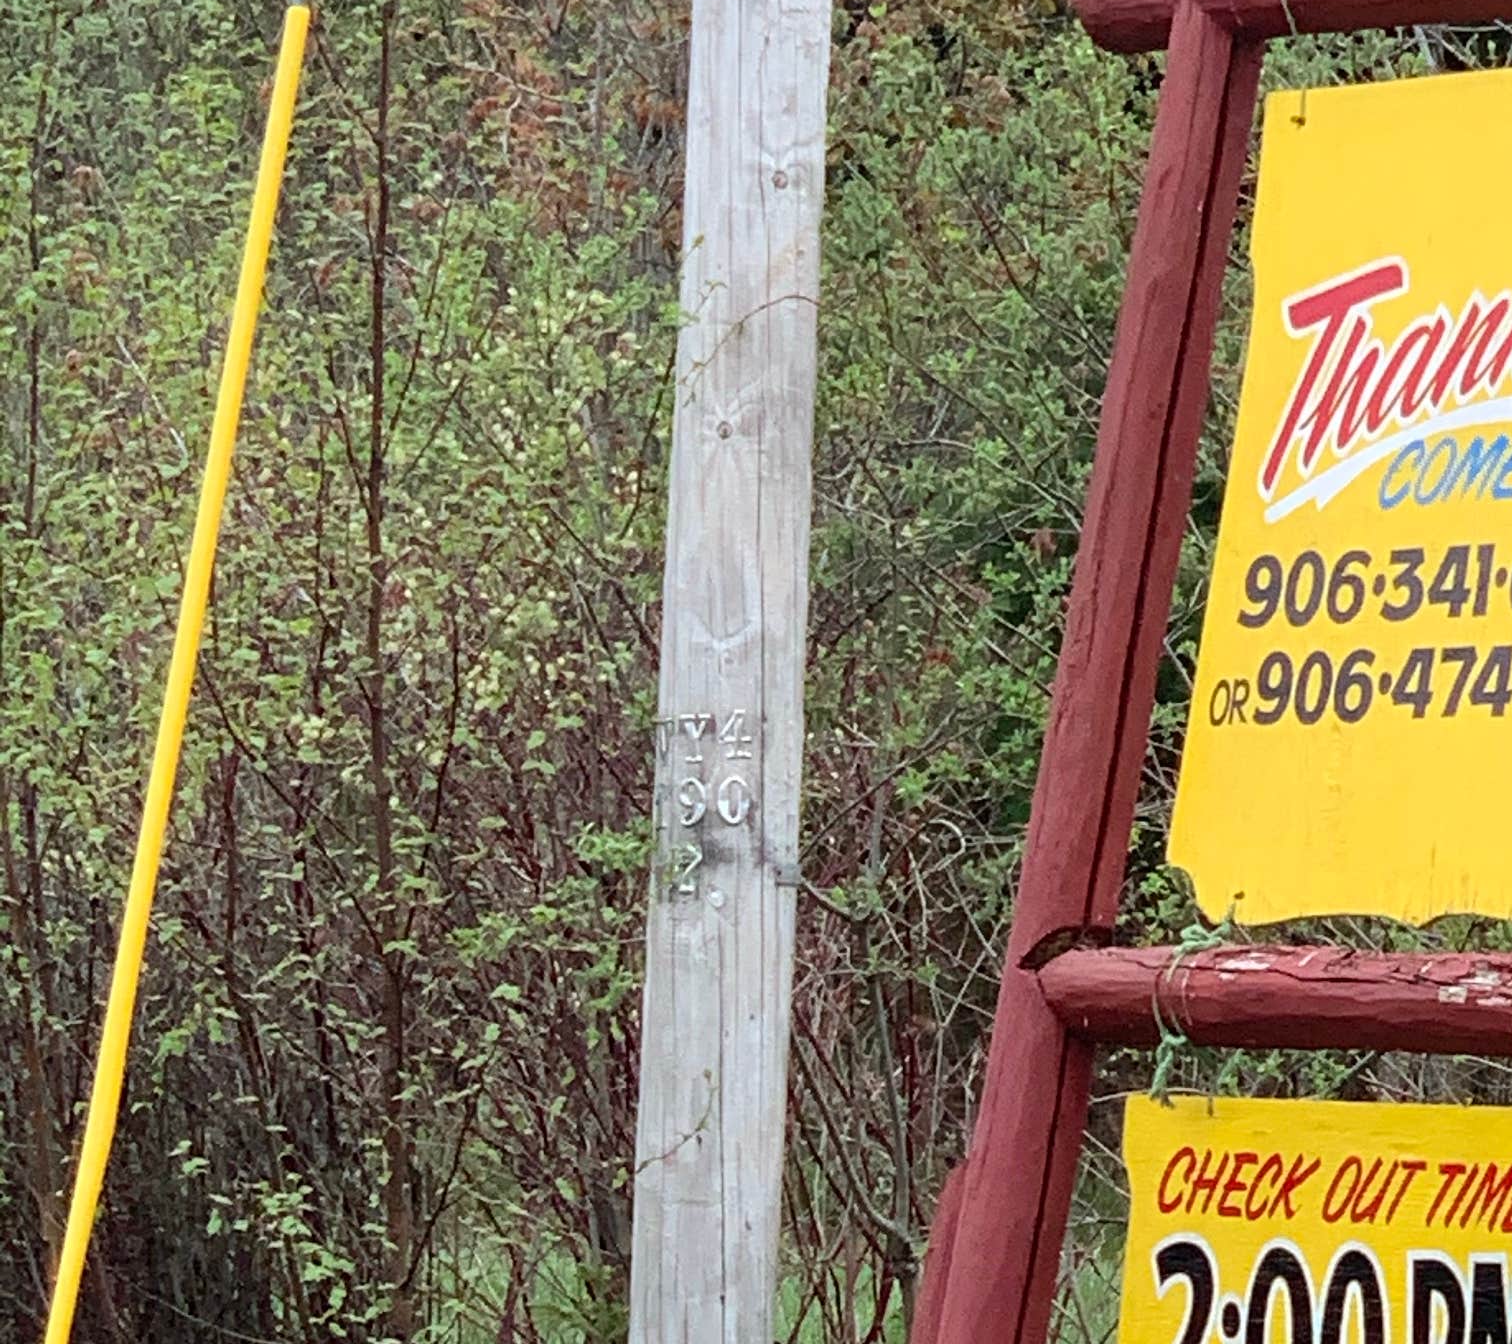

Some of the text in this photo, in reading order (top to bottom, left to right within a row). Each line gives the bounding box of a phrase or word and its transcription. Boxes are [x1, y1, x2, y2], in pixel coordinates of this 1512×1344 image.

[1209, 678, 1251, 728] OR
[1156, 1146, 1321, 1221] CHECK
[1321, 1156, 1427, 1225] OUT
